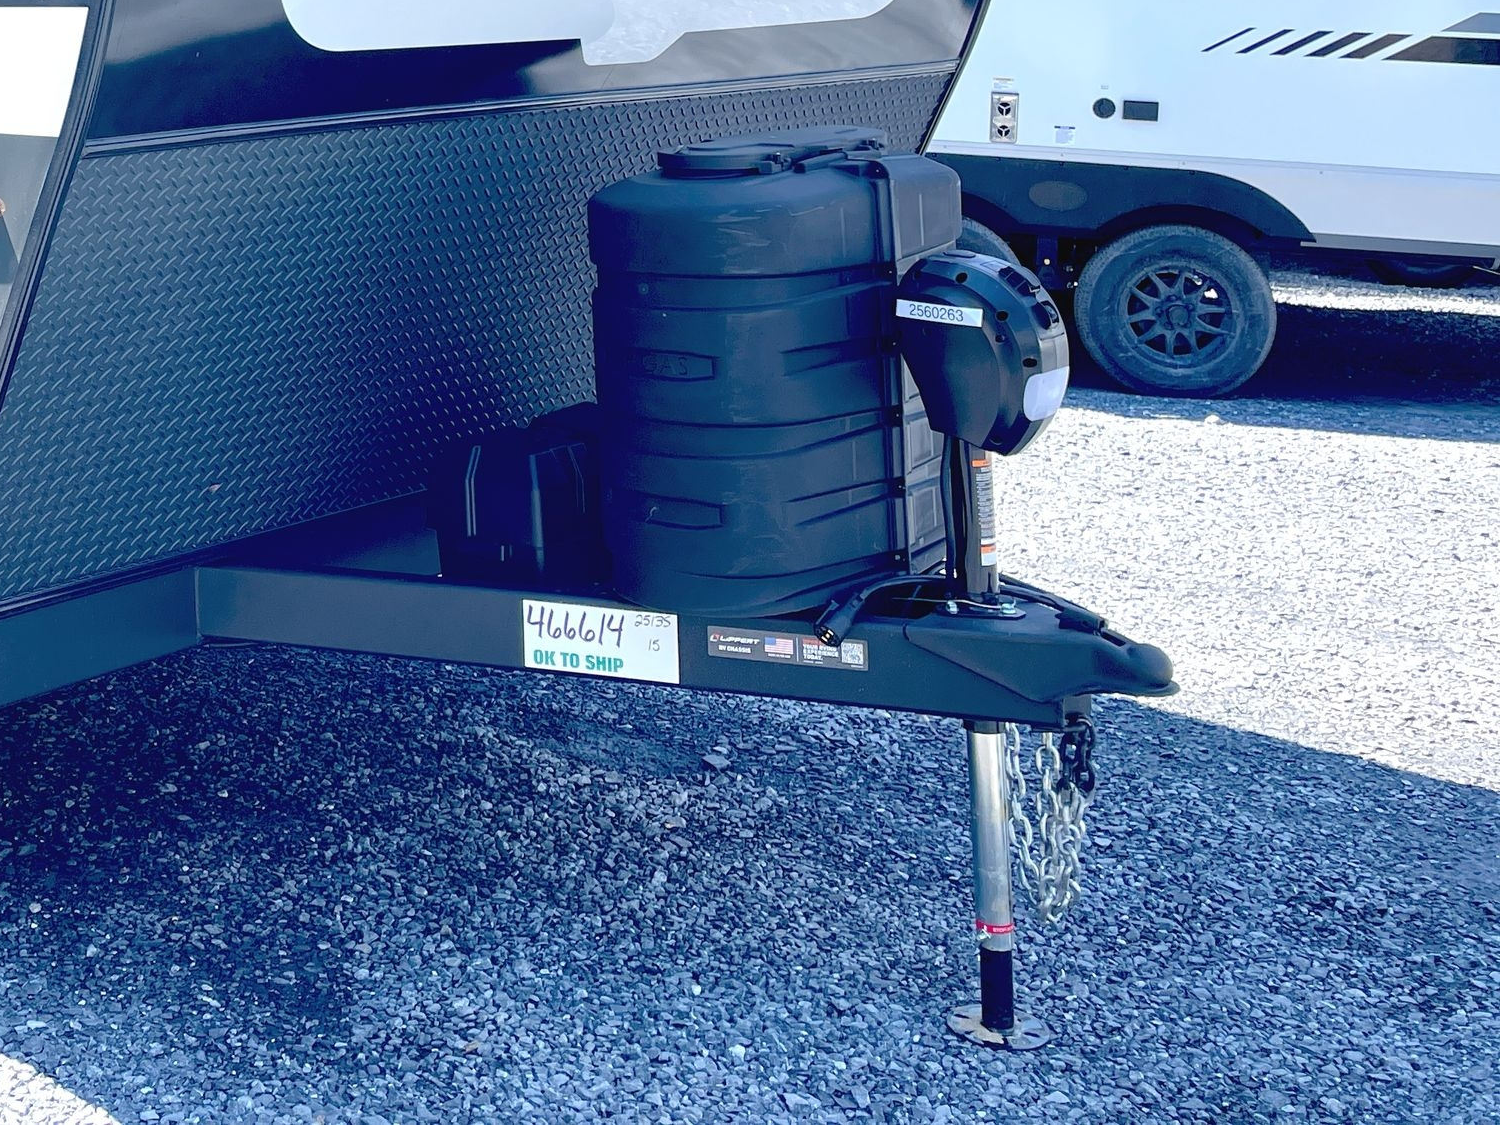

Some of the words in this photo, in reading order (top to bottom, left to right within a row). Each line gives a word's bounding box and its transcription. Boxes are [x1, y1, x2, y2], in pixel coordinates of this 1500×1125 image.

[909, 303, 964, 322] 2560263
[526, 604, 625, 648] 466614
[648, 639, 660, 652] 15
[533, 649, 556, 666] OK
[560, 652, 580, 668] TO
[585, 654, 624, 673] SHIP
